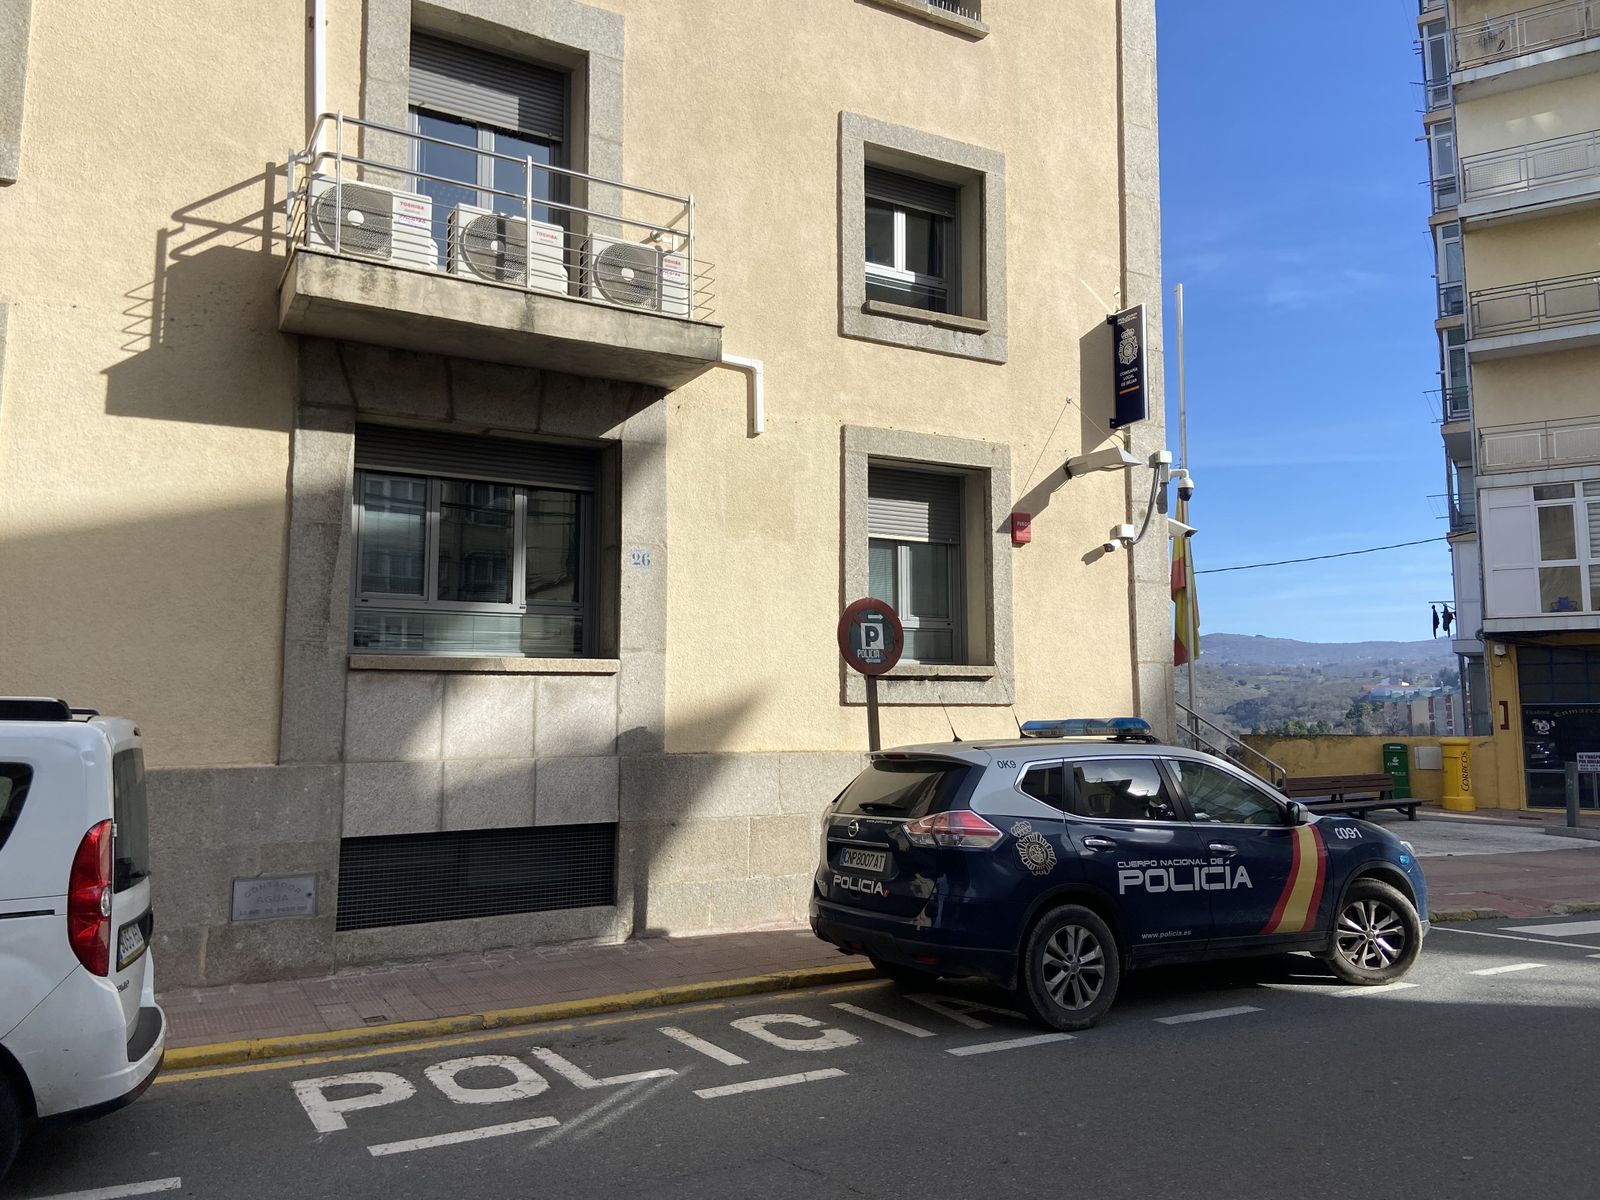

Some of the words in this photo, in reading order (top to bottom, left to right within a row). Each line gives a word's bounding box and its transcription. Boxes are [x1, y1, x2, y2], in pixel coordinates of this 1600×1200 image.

[400, 201, 425, 210] TOSHIBA
[536, 230, 558, 240] TOSHIBA
[663, 257, 681, 266] OSHIBA
[632, 552, 651, 566] 26
[864, 625, 880, 648] P
[857, 649, 881, 659] POLICIA
[845, 850, 885, 870] CNP8007AT
[1117, 859, 1158, 868] CUERPO
[1160, 858, 1207, 867] NACIONAL
[1210, 857, 1223, 865] DE
[257, 894, 289, 904] AGUA
[1141, 929, 1192, 940] www.policia.es
